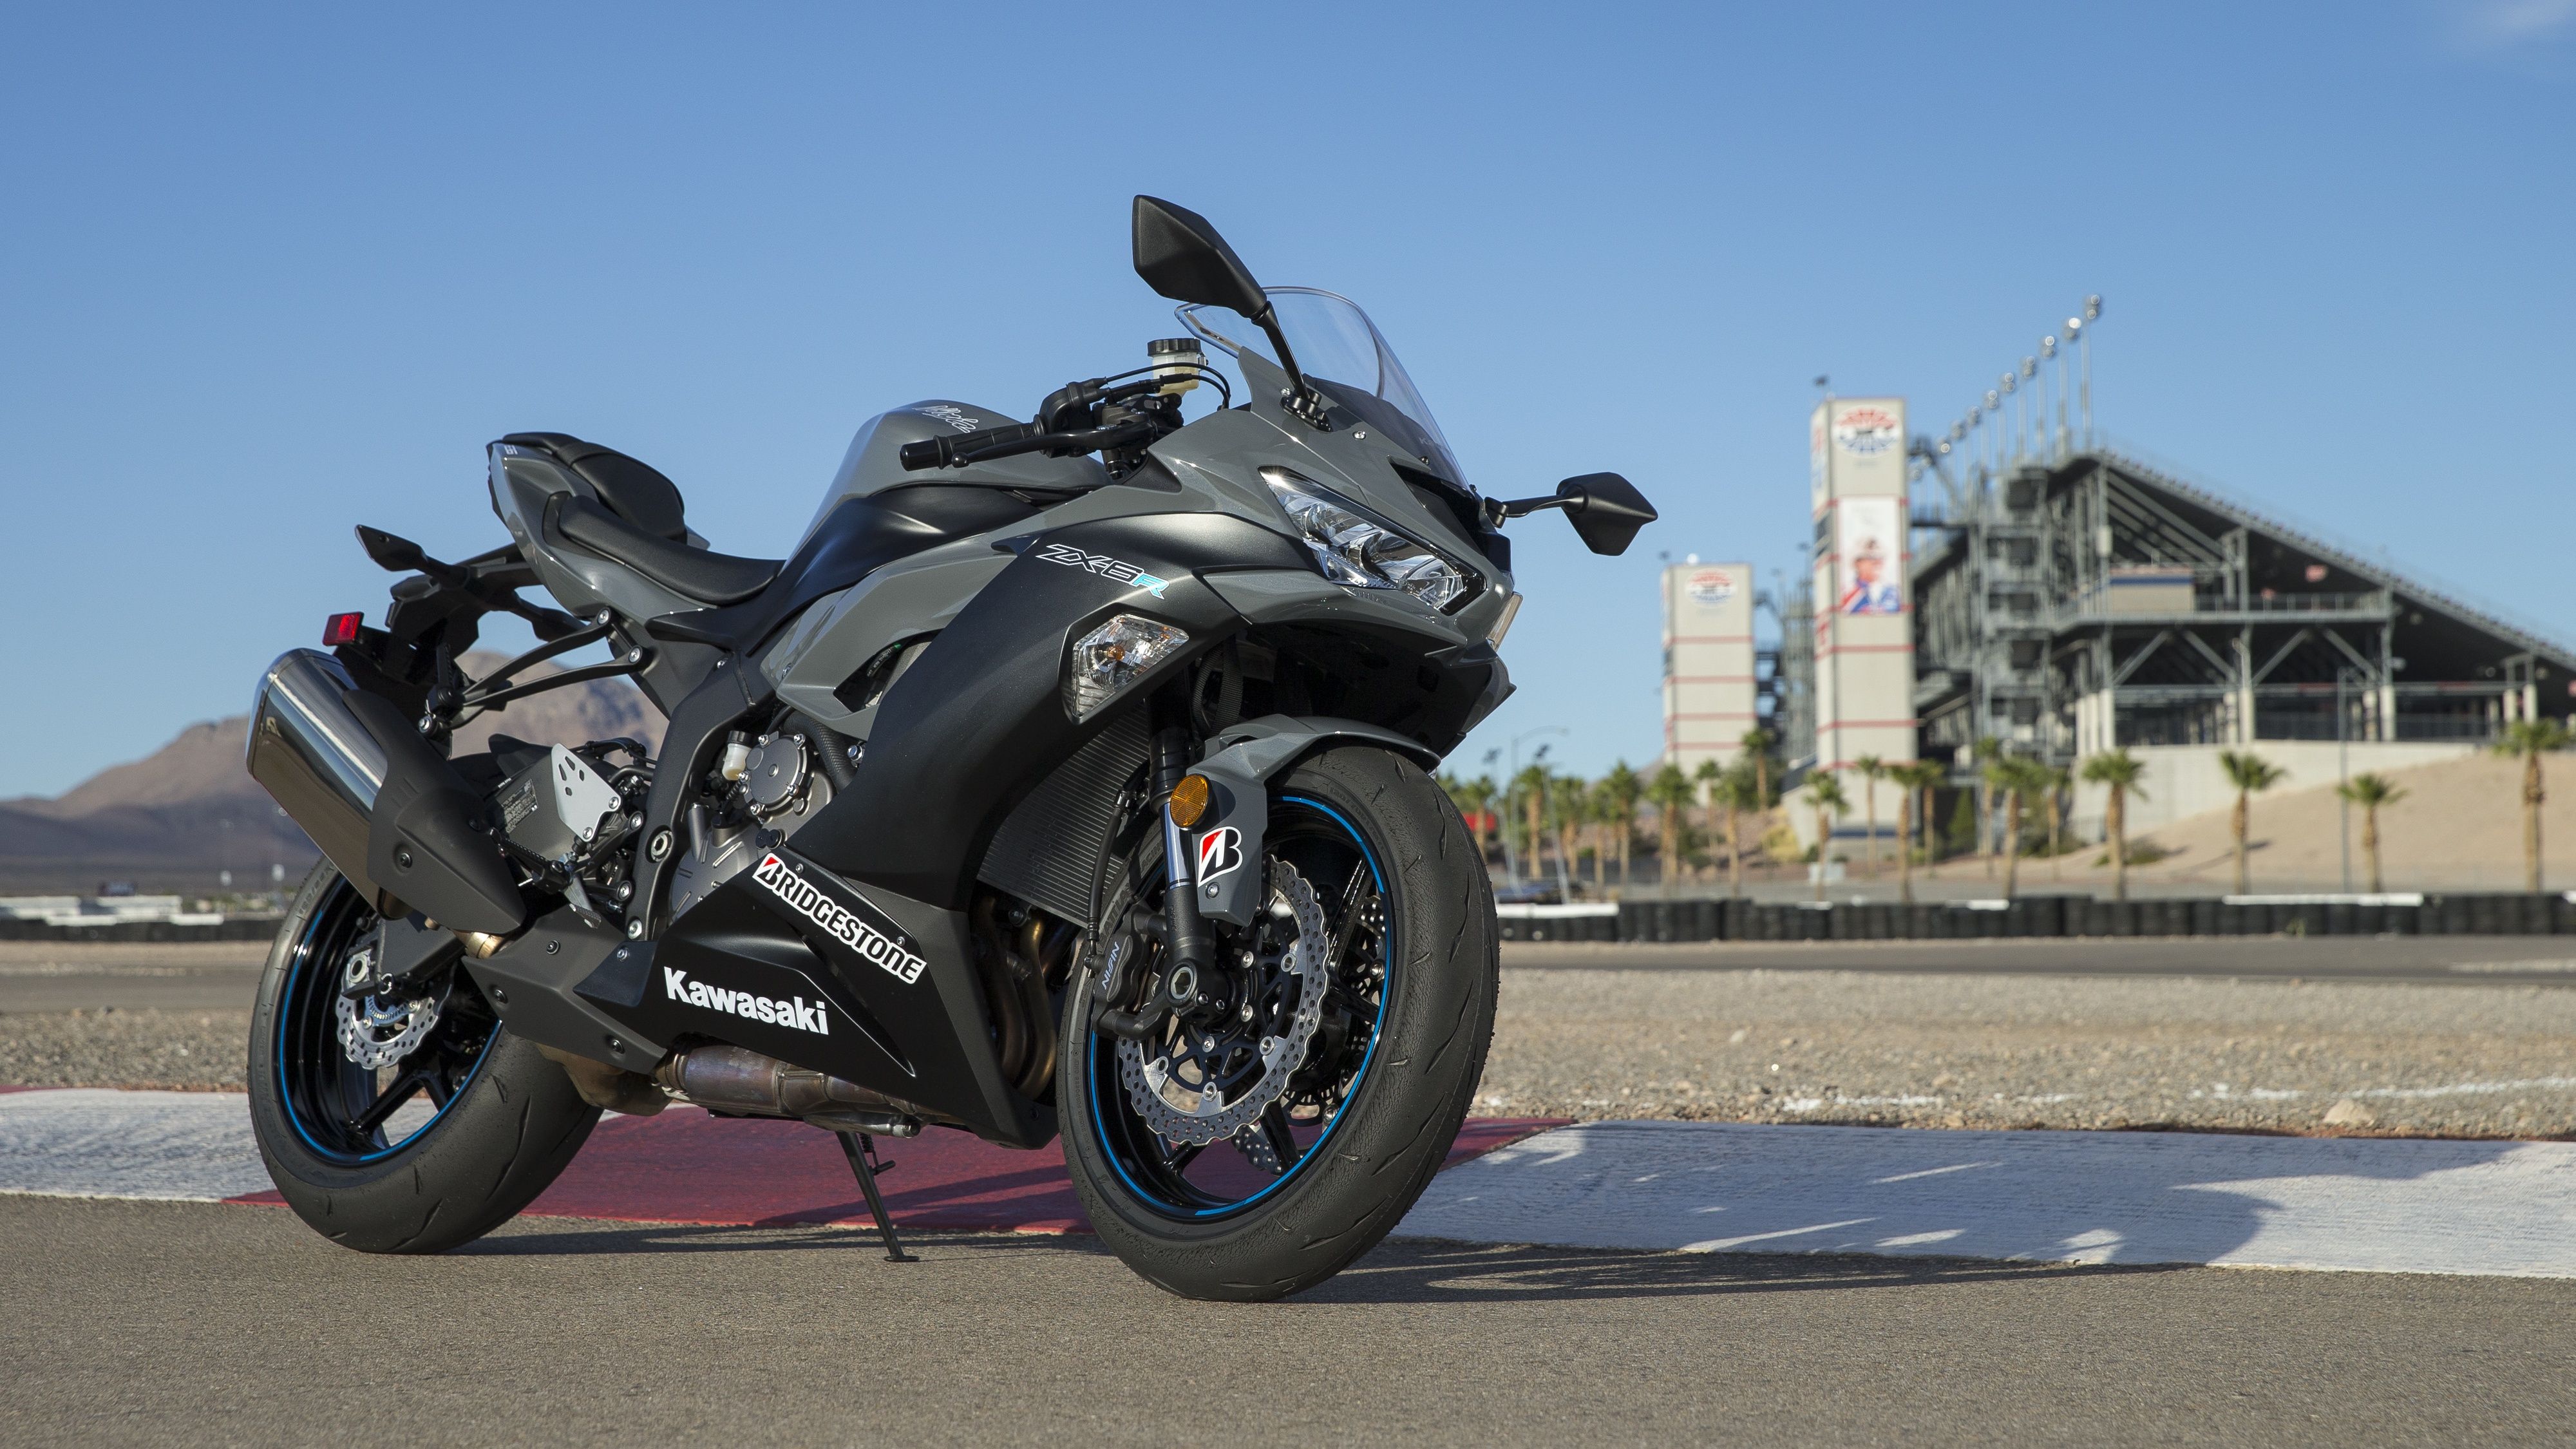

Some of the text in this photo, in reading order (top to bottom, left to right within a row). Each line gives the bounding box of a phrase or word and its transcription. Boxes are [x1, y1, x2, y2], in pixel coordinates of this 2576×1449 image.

[1036, 544, 1170, 600] ZX-6R
[753, 855, 925, 983] BRIDGESTONE
[1101, 941, 1120, 990] NISSIN
[663, 966, 829, 1035] Kawasaki
